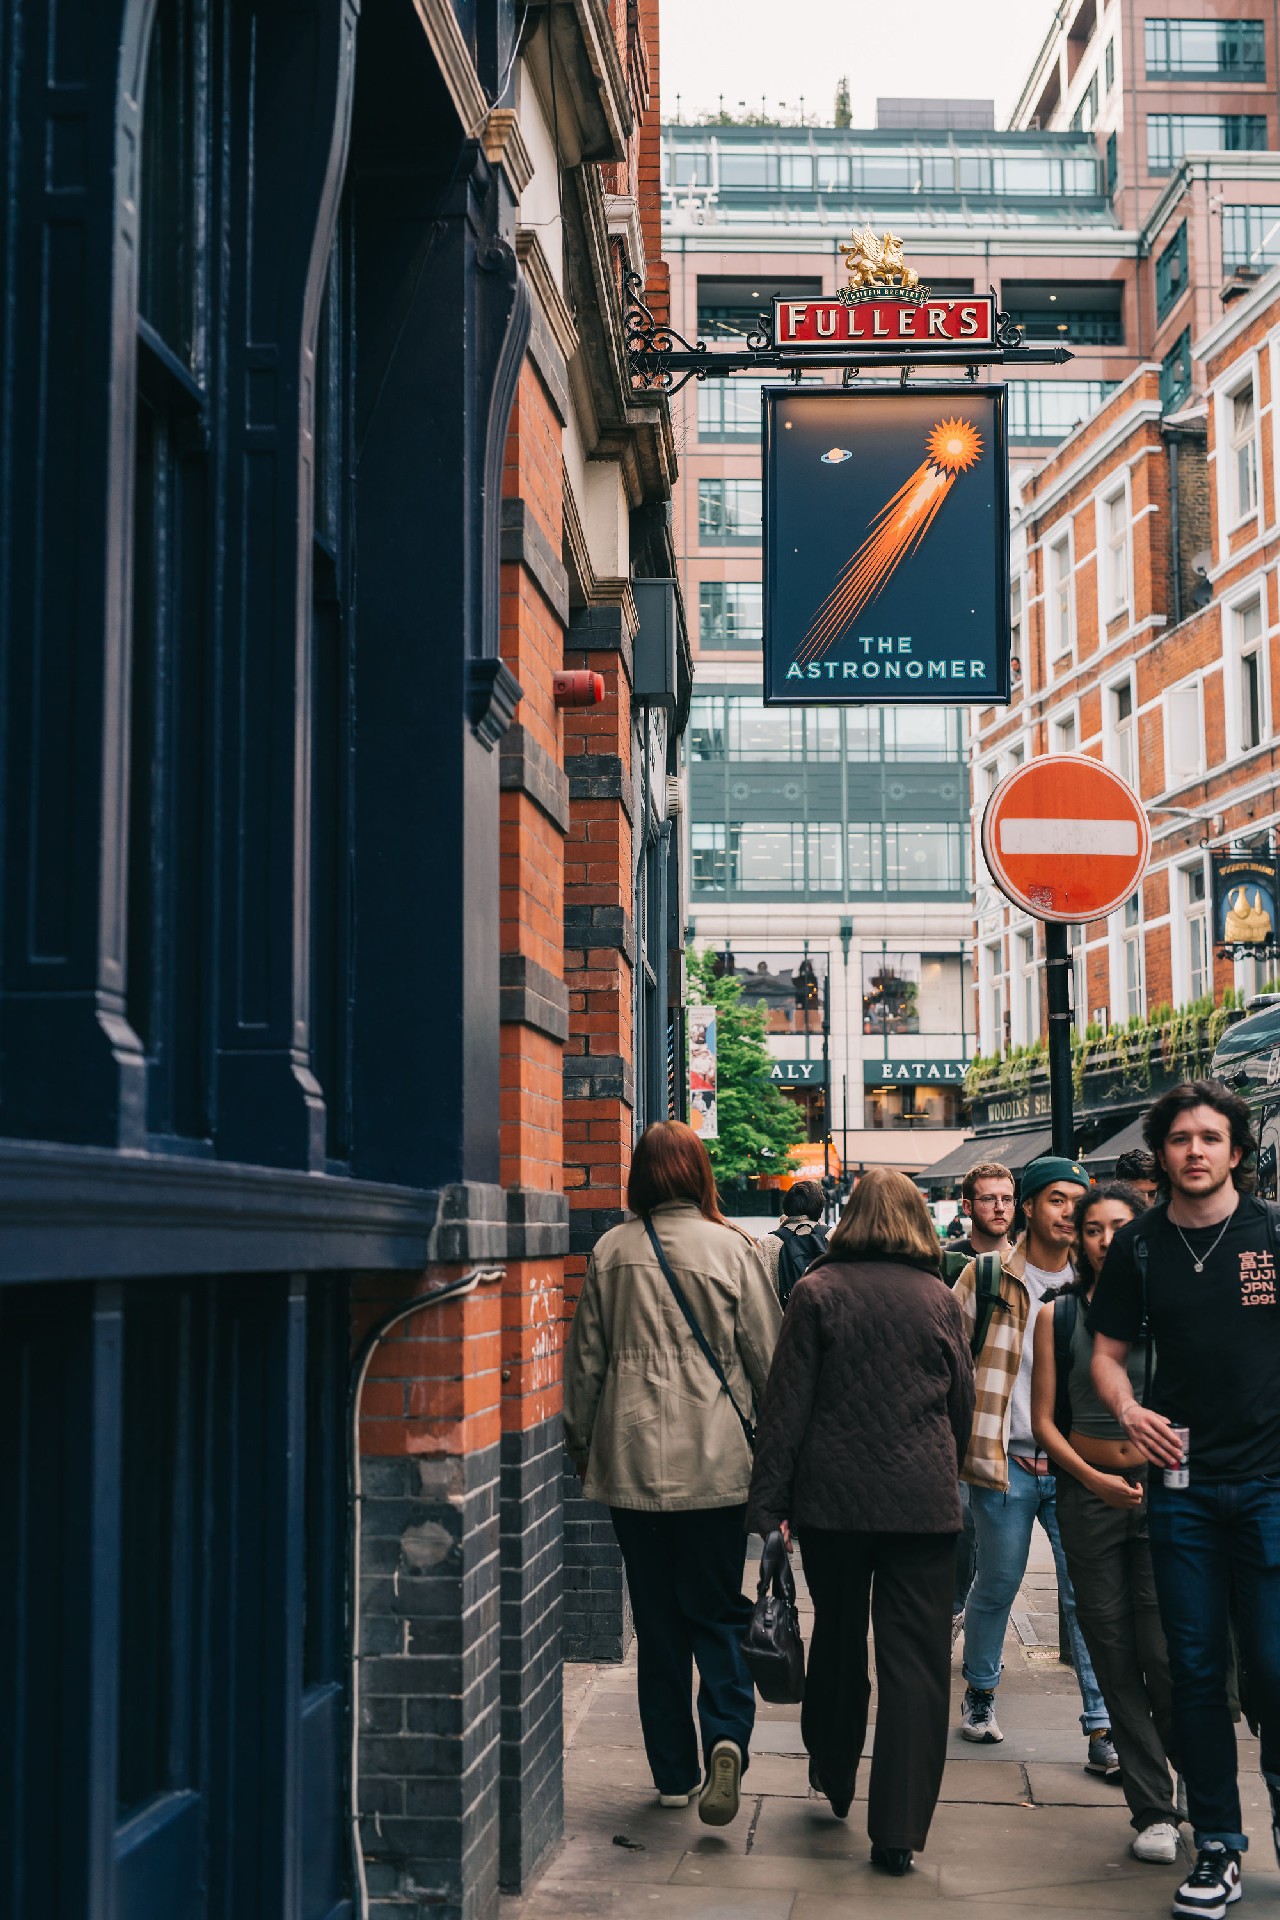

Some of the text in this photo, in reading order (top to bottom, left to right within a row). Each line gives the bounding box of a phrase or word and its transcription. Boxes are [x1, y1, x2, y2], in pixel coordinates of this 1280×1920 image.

[850, 289, 920, 300] GRIFFIN BREWERY
[788, 302, 979, 340] FULLER'S
[859, 636, 913, 654] THE
[785, 660, 987, 679] ASTRONOMER
[881, 1063, 970, 1079] EATALY
[988, 1097, 1030, 1122] WOODIN'S
[1238, 1250, 1274, 1270] 富士
[1239, 1269, 1276, 1282] FUJI
[1241, 1281, 1277, 1293] JPN.
[1241, 1293, 1276, 1306] 1991
